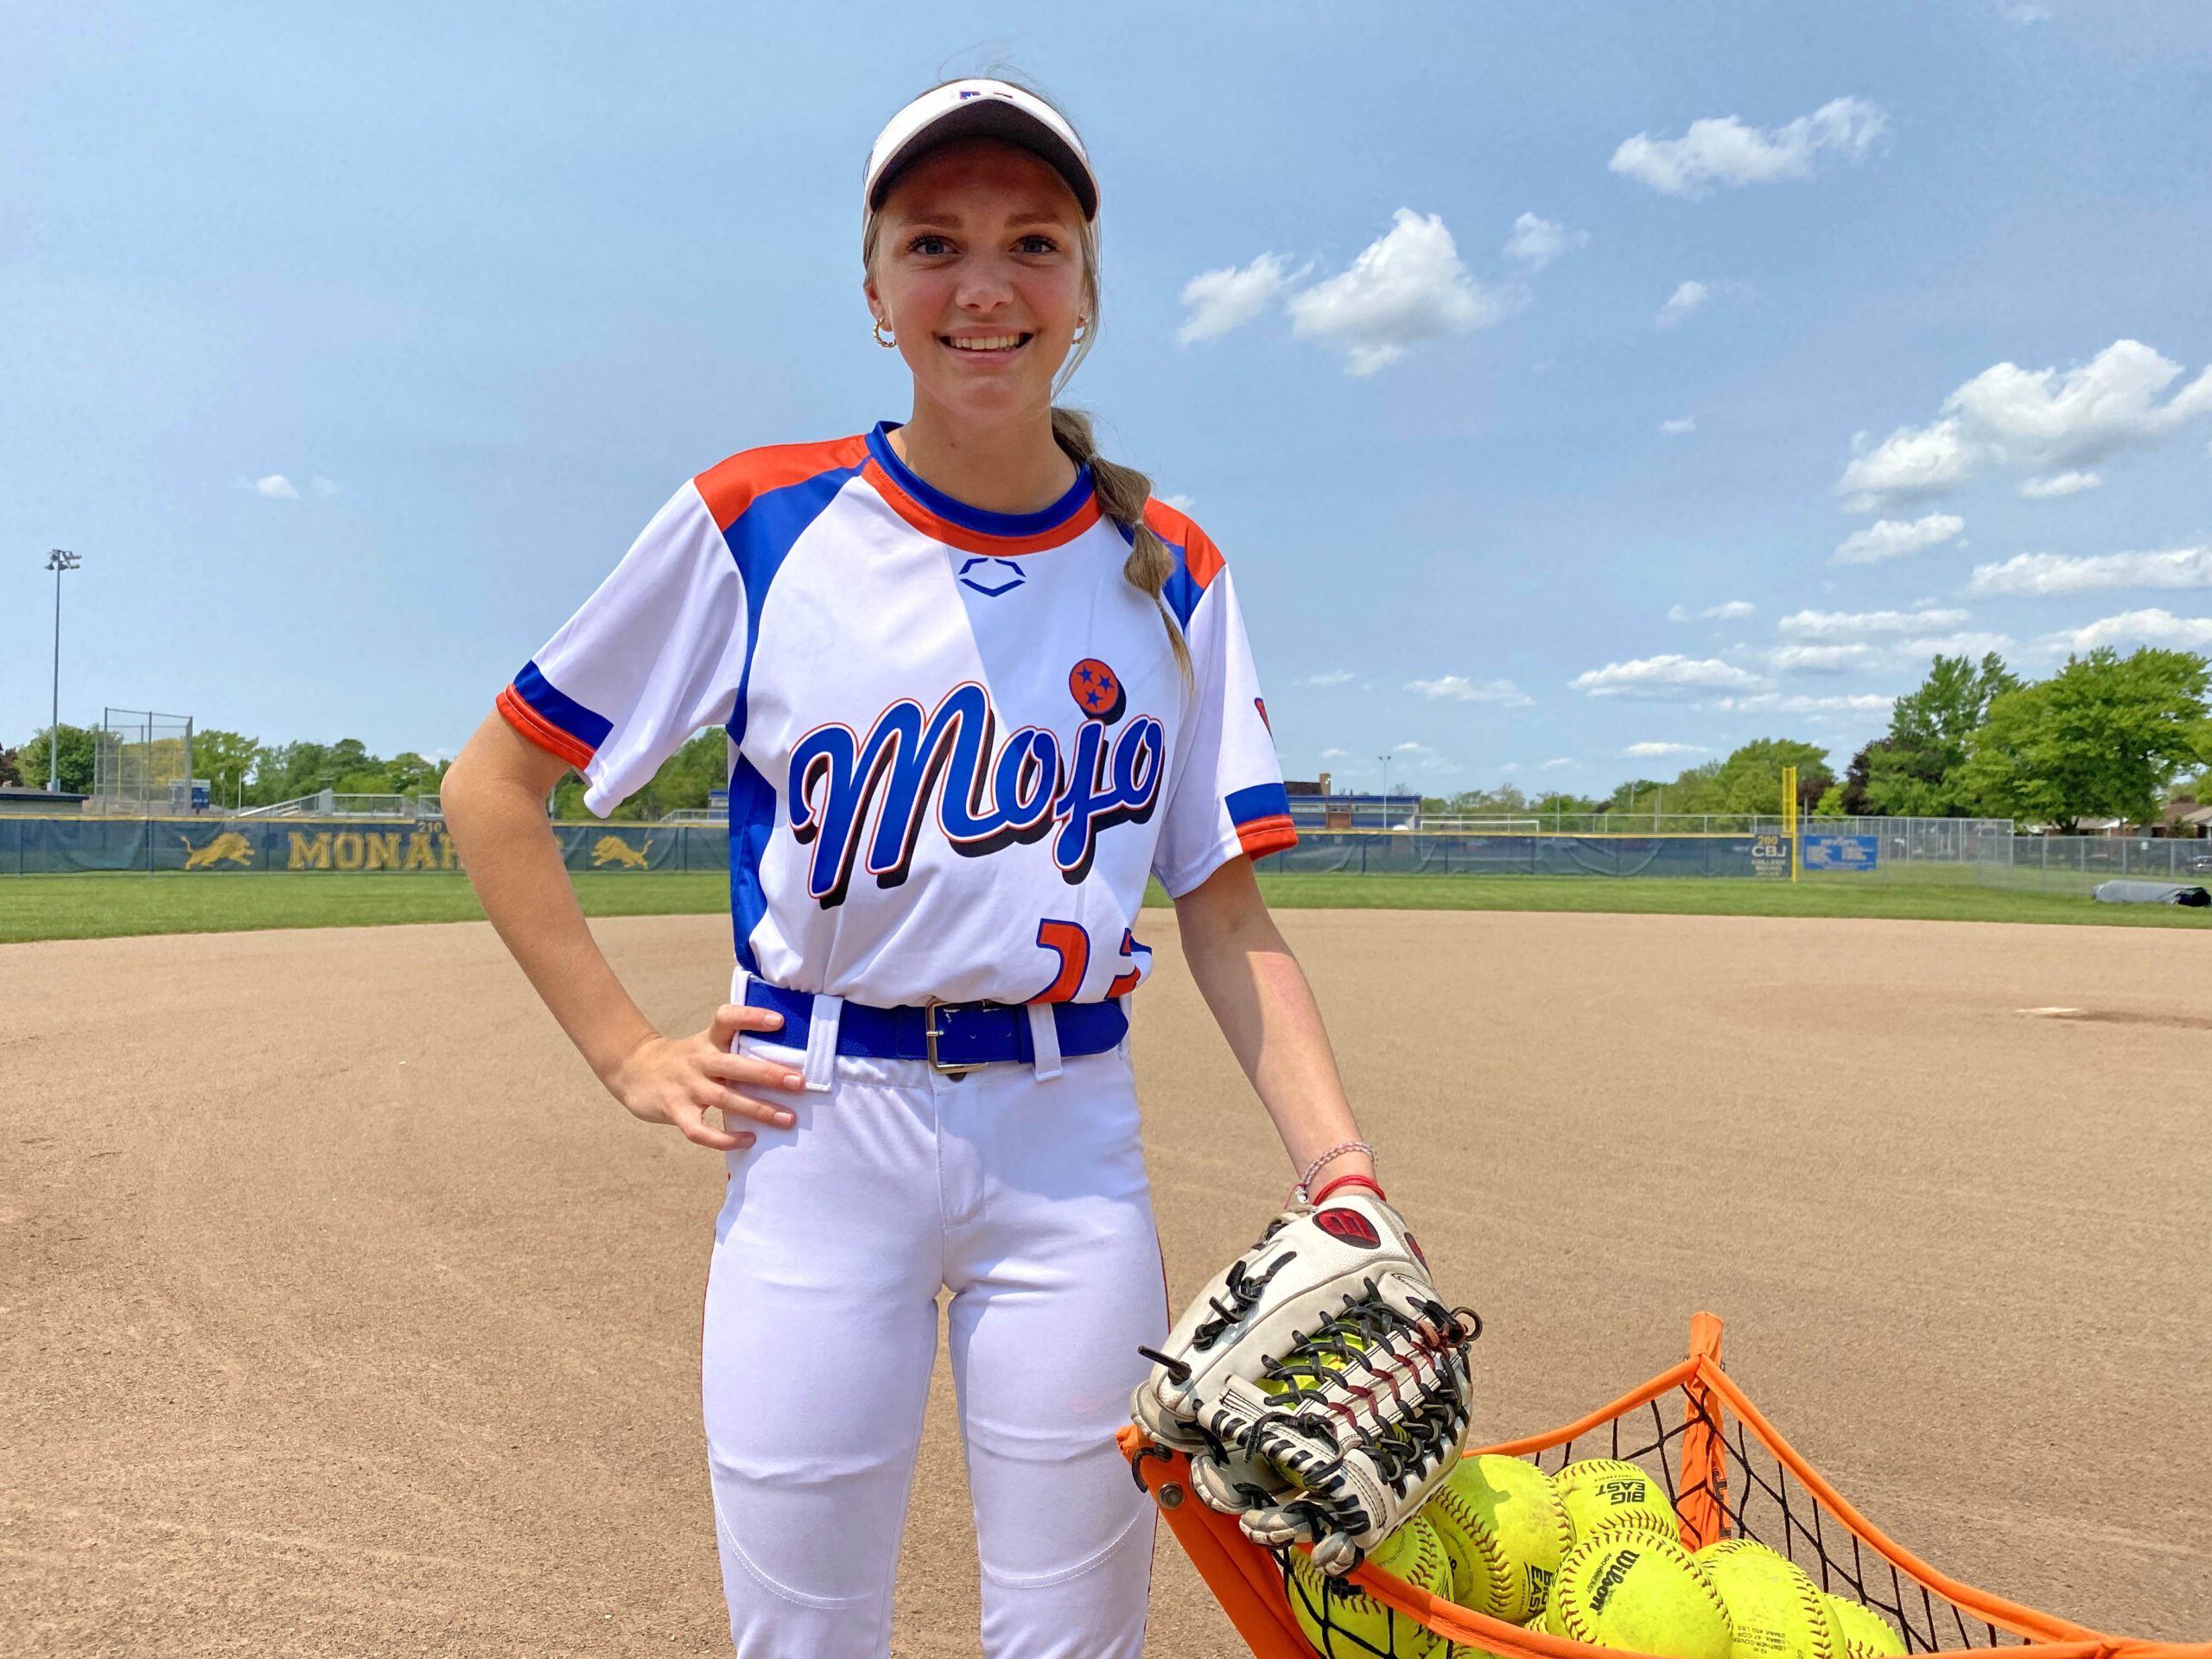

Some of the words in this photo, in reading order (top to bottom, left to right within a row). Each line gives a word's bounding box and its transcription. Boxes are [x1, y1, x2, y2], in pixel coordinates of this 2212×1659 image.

[788, 658, 1166, 910] Mojo
[418, 822, 442, 833] 210
[1758, 835, 1778, 846] 200
[1751, 845, 1786, 857] CBJ
[1595, 1481, 1645, 1497] EAST
[1611, 1491, 1645, 1505] BIG
[1589, 1550, 1640, 1611] Wilson
